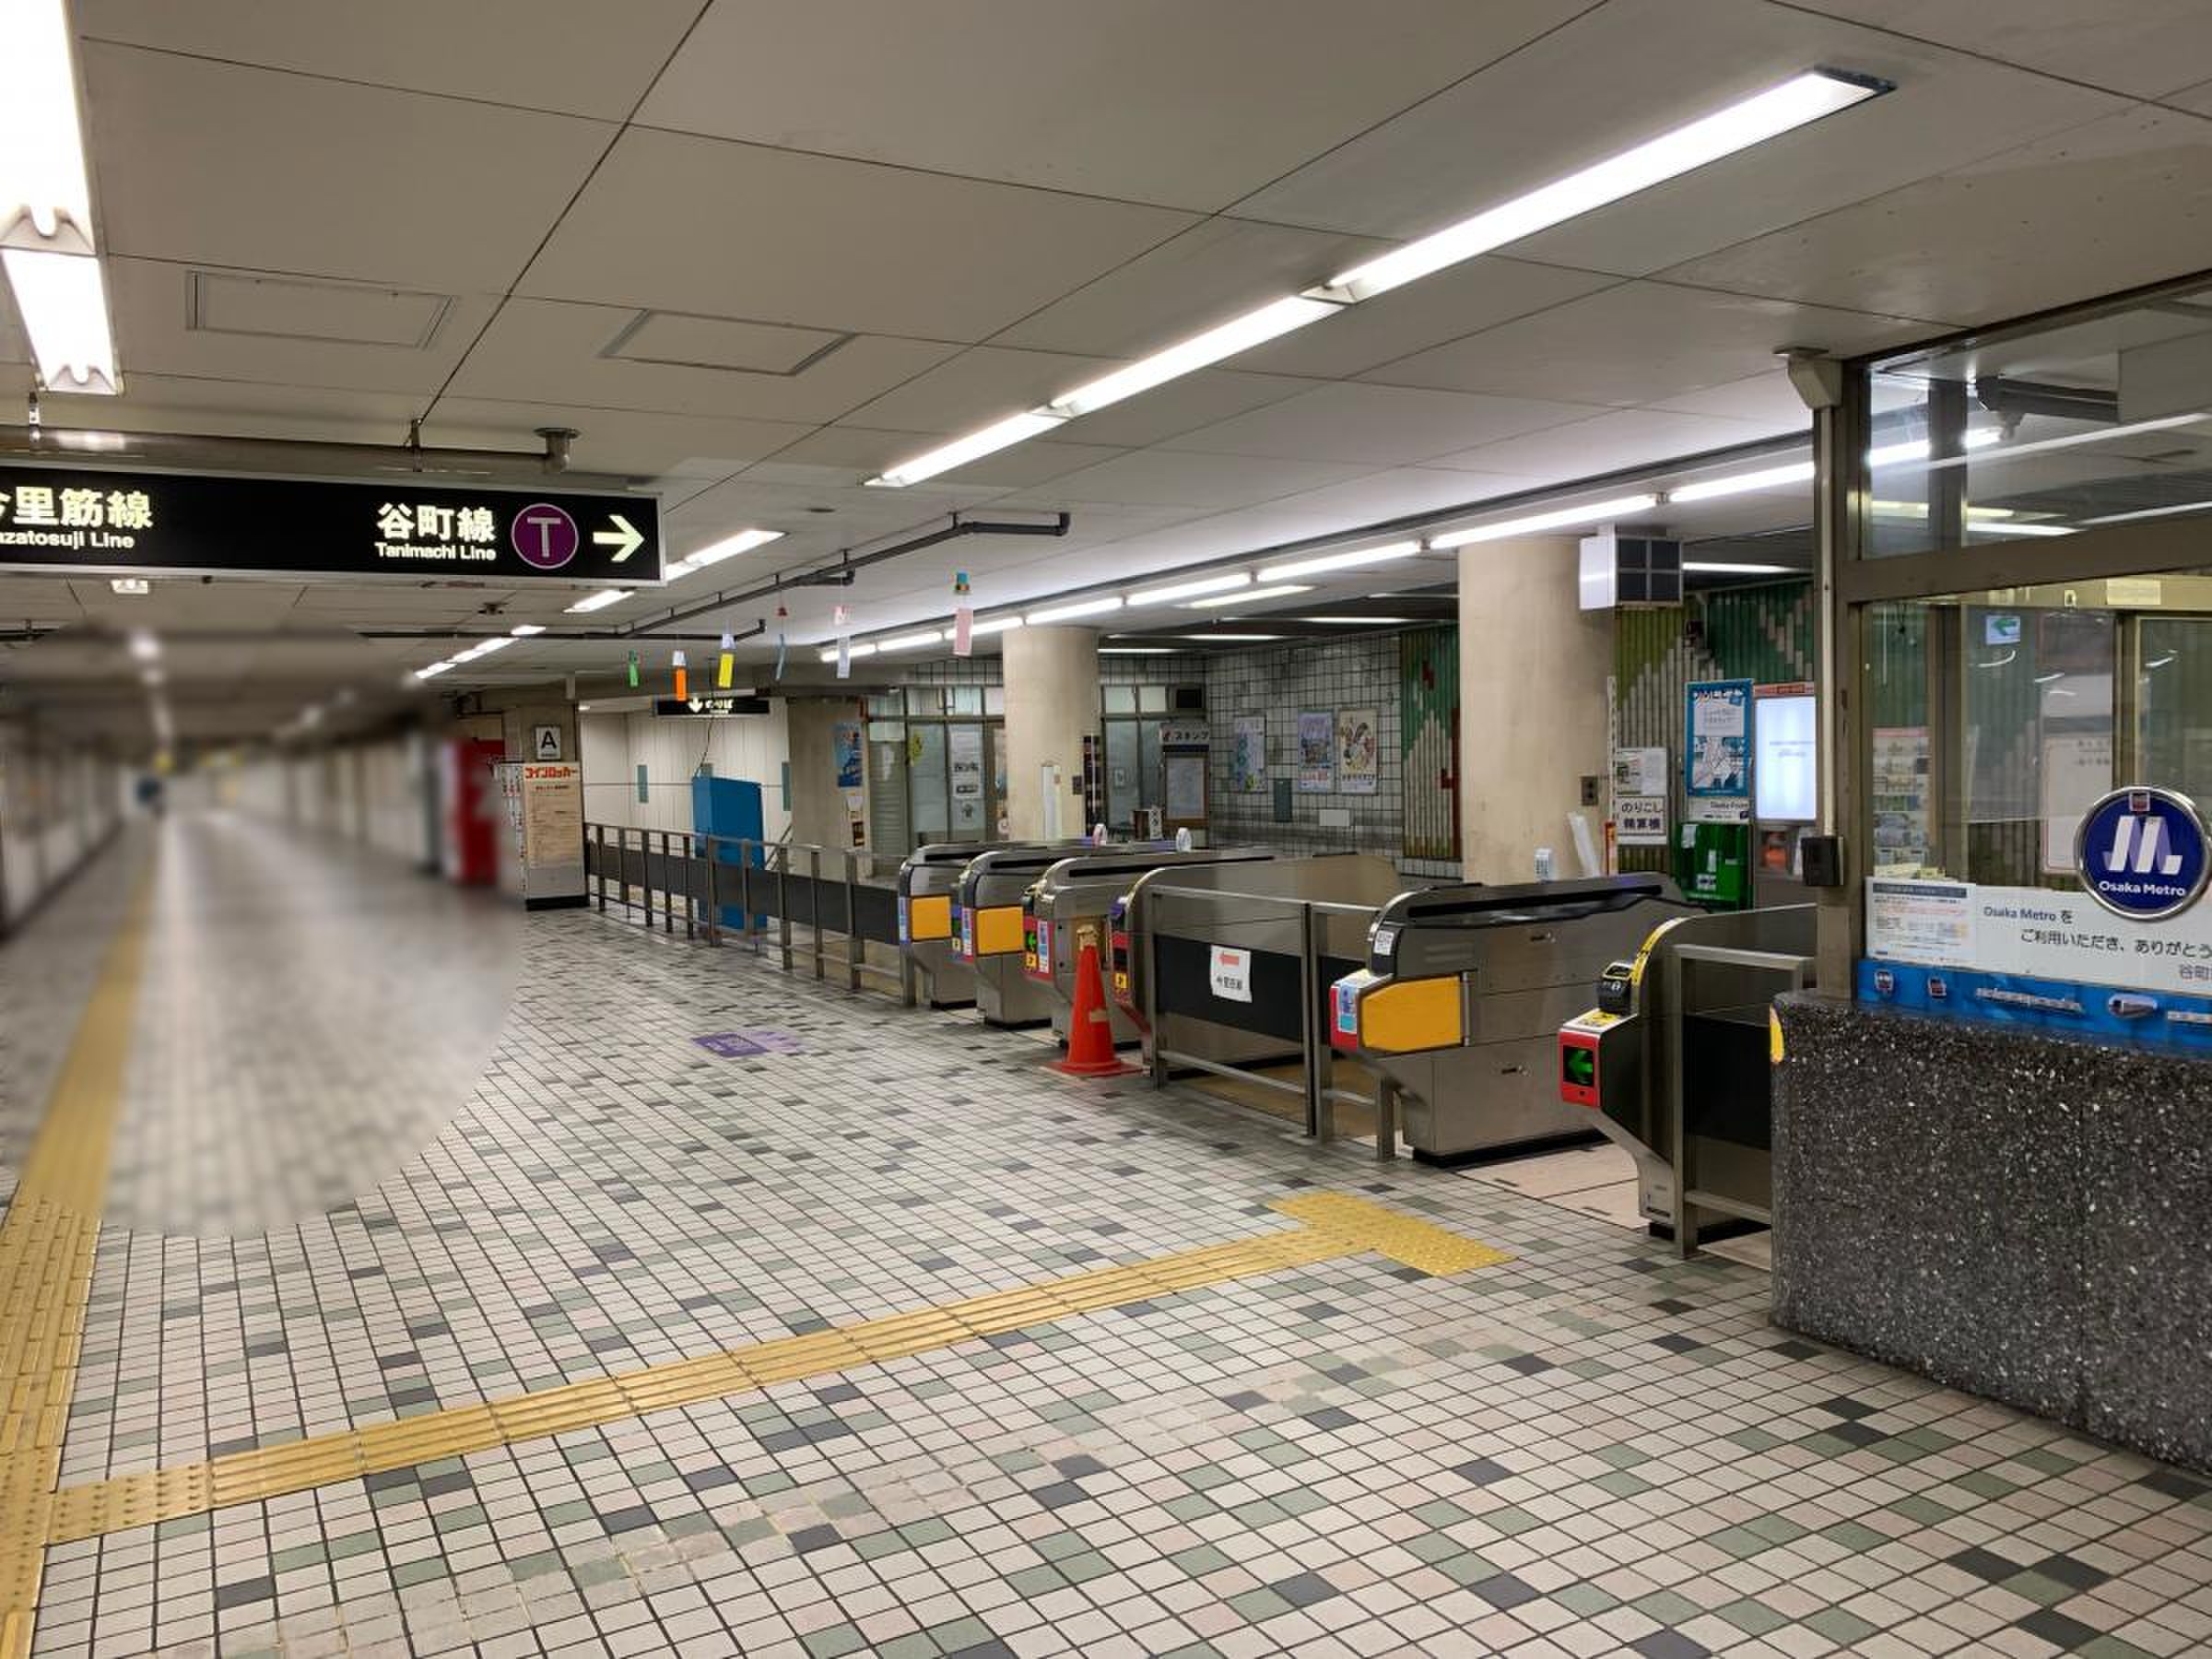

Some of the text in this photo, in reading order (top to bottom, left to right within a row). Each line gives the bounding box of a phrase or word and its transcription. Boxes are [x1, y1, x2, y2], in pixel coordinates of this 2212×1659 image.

[0, 487, 153, 529] 里筋線
[377, 503, 495, 542] 谷町線
[90, 532, 135, 548] Line
[527, 517, 561, 558] T
[374, 542, 496, 560] Tanimachi Line
[541, 730, 557, 748] A
[1621, 802, 1664, 813] のりこし
[2099, 880, 2186, 897] Osaka Metro
[1983, 906, 2074, 924] Osaka Metro を
[2179, 964, 2212, 979] 谷町
